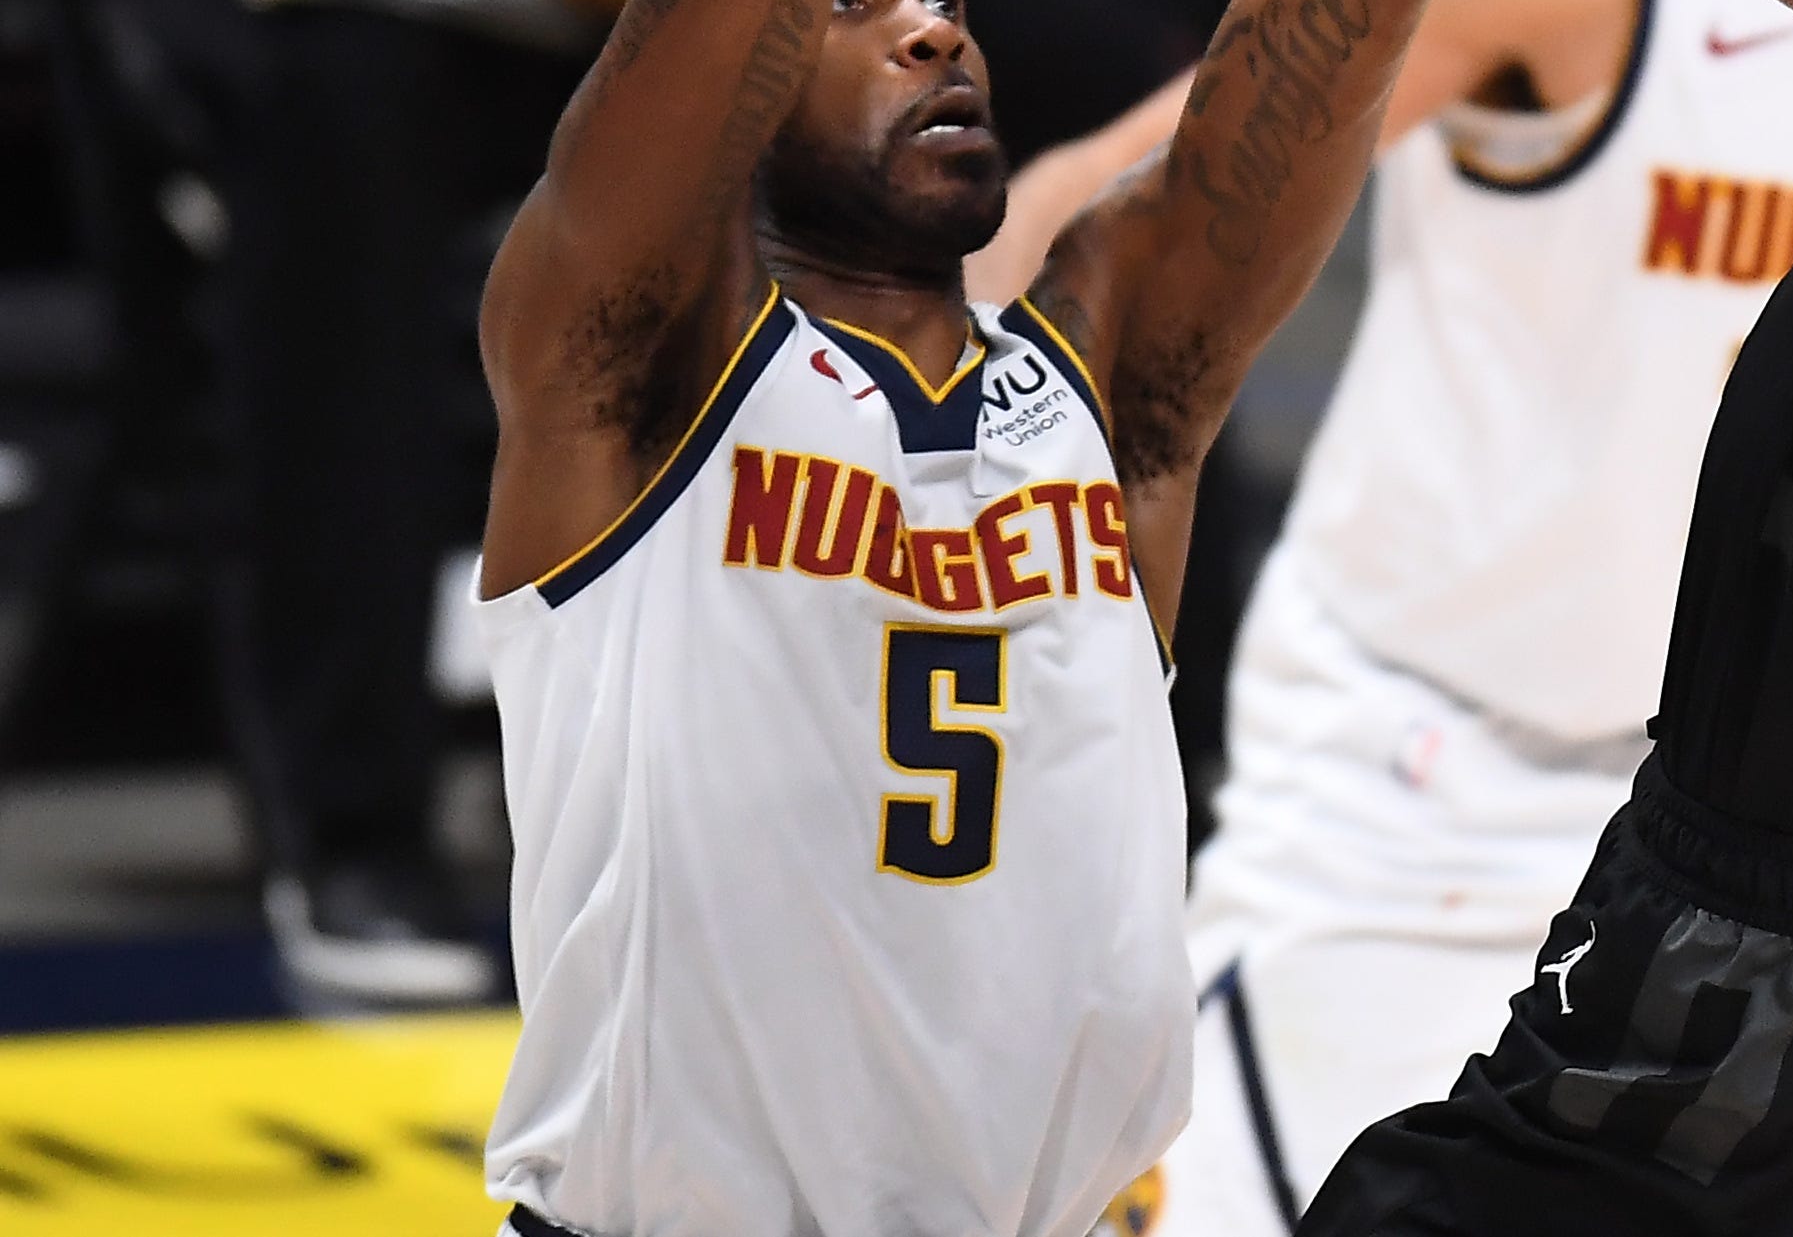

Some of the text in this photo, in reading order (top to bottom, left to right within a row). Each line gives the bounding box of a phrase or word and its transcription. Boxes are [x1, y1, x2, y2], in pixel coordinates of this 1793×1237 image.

[982, 387, 1069, 440] Western
[1004, 409, 1068, 447] Union
[723, 443, 1134, 614] NUGGETS
[875, 620, 1008, 887] 5
